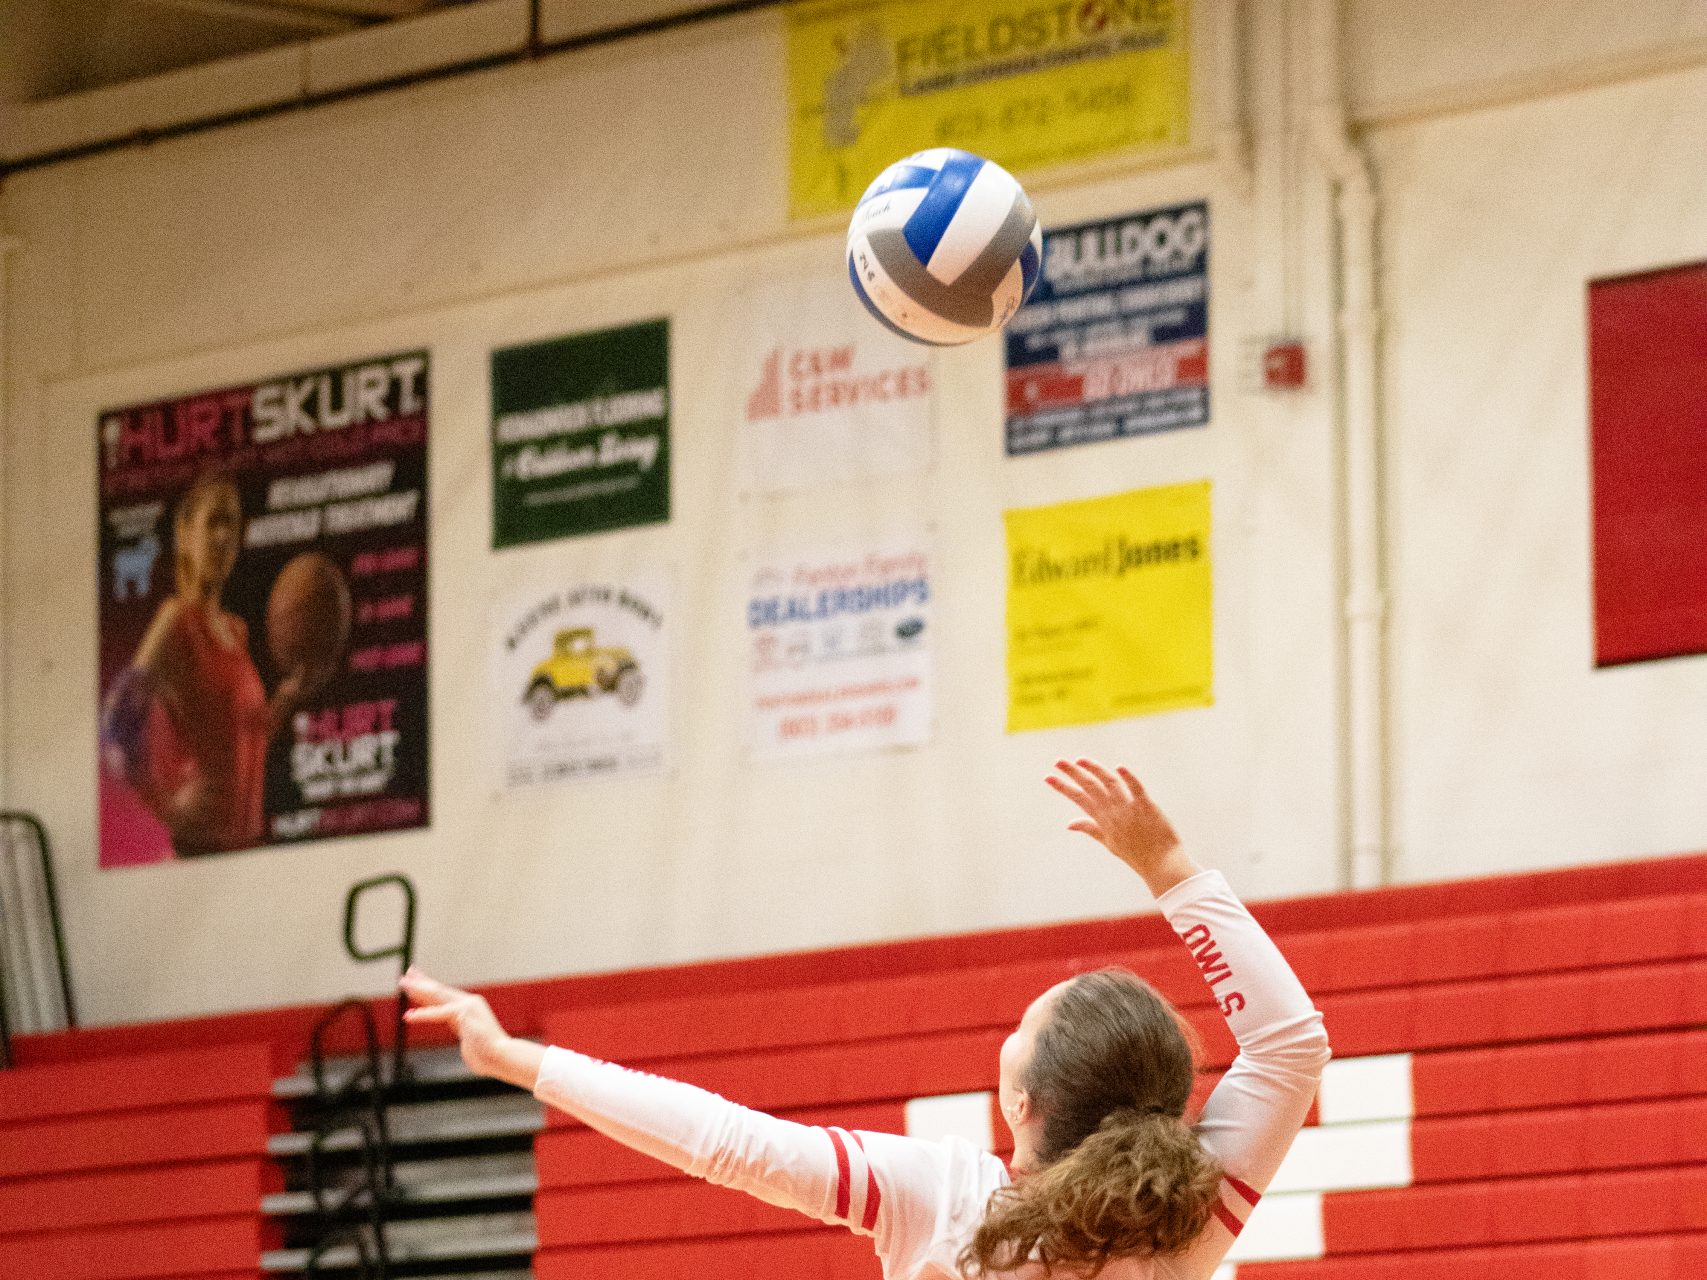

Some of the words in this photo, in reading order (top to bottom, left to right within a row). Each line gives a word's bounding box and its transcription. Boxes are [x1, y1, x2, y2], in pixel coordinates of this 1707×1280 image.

[899, 0, 1172, 68] FIELDSTONE
[1045, 210, 1208, 276] BULLDOG
[791, 366, 934, 416] SERVICES
[1014, 536, 1113, 588] Edward
[1117, 531, 1202, 580] Jones
[747, 578, 928, 630] DEALERSHIPS
